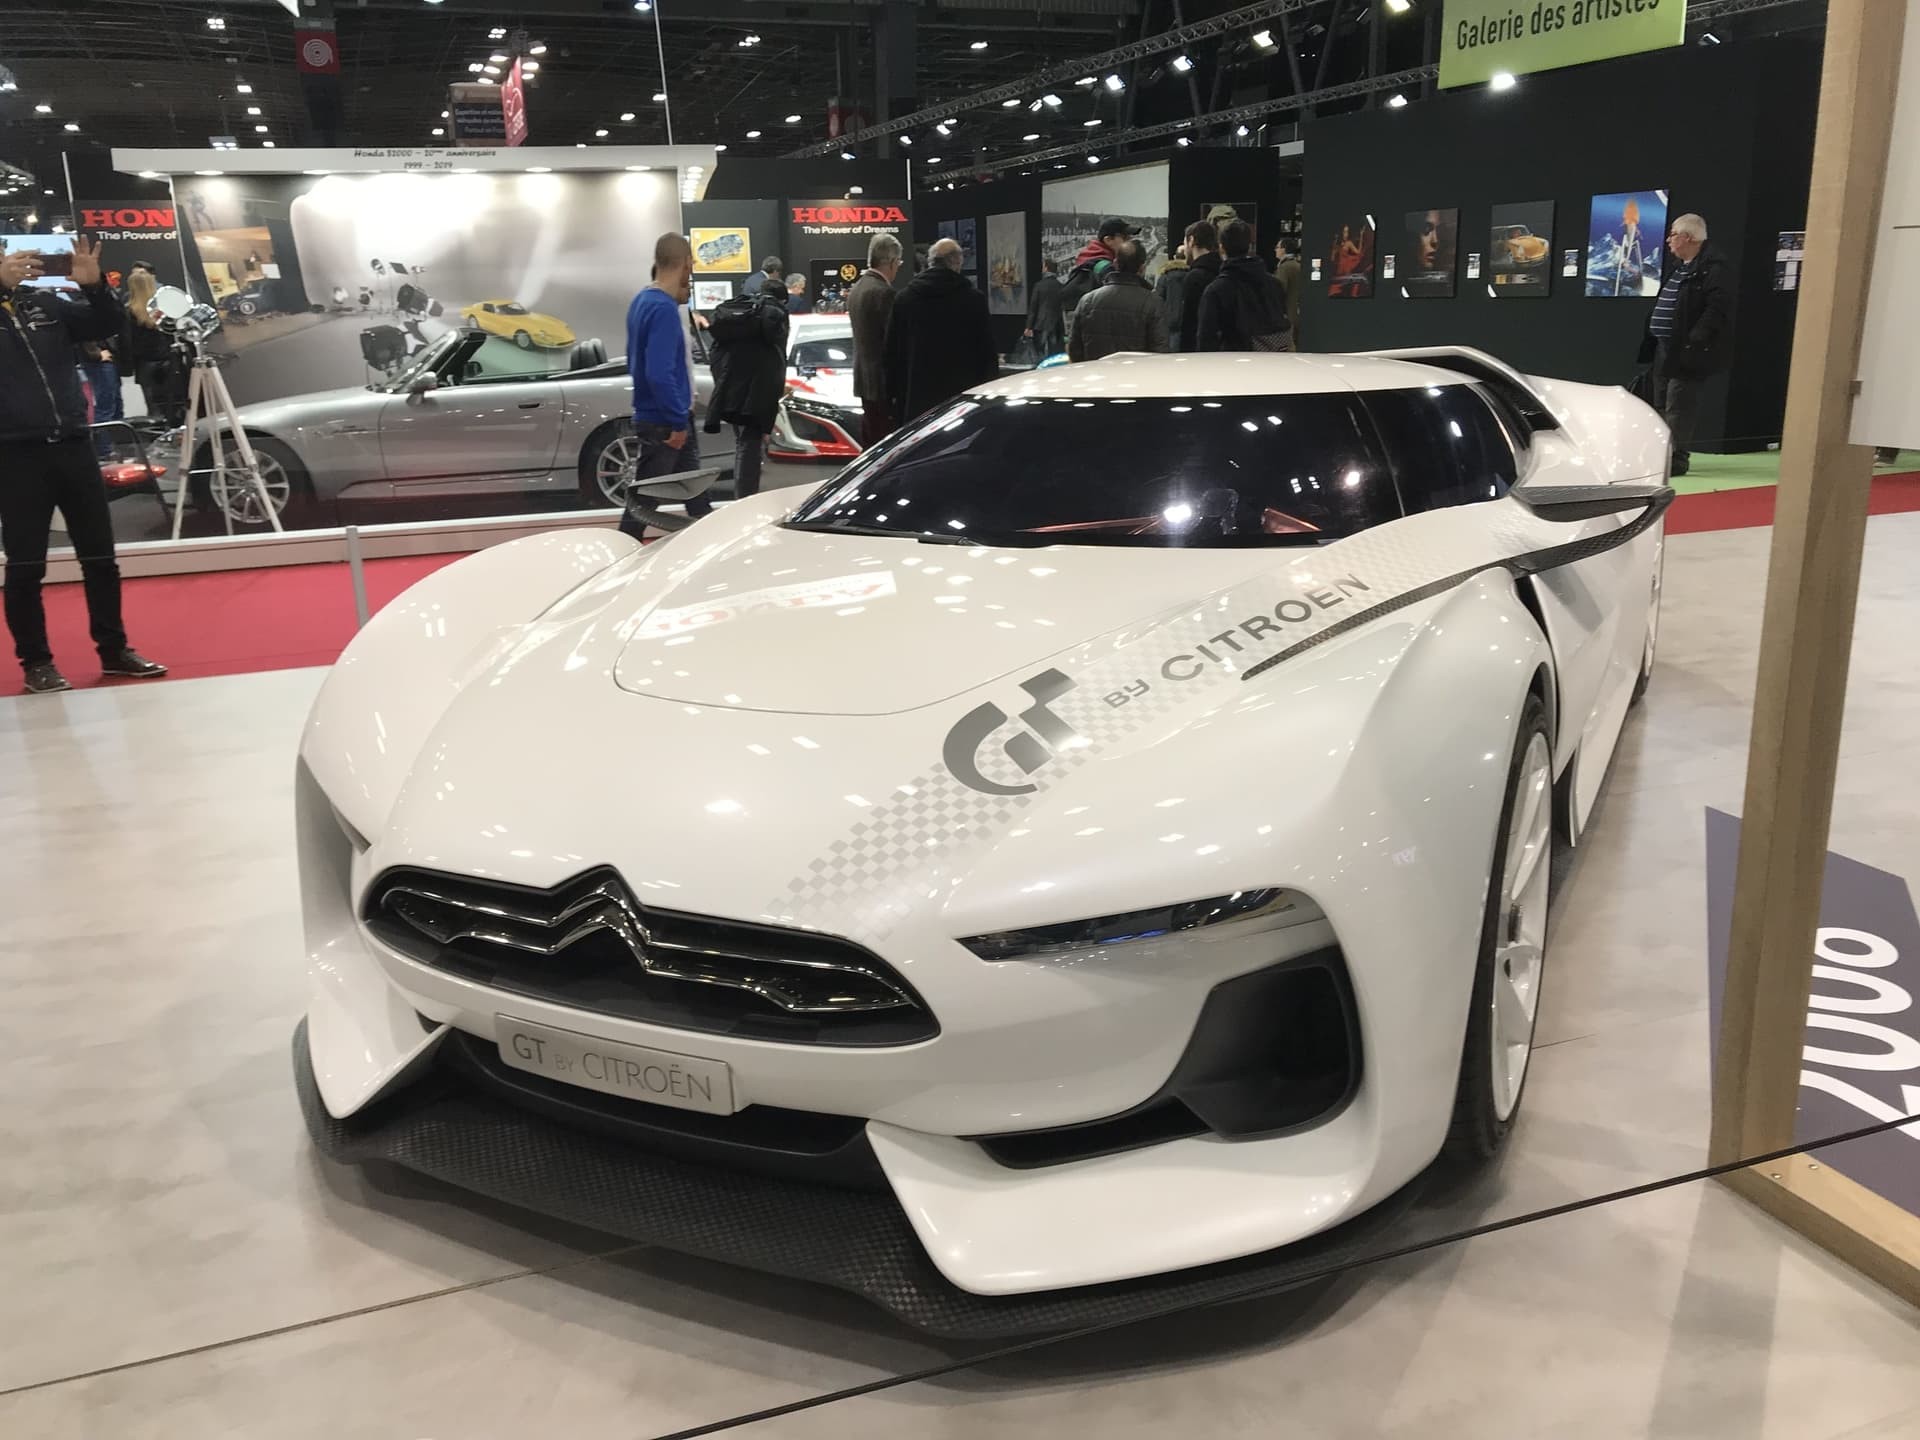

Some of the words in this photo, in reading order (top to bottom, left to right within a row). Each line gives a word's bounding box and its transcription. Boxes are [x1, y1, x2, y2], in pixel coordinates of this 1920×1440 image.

[1457, 9, 1523, 50] Galerie
[1531, 2, 1565, 35] des
[354, 149, 384, 157] Honda
[387, 149, 413, 157] S2000
[446, 148, 496, 157] anniversaire
[791, 207, 909, 223] HONDA
[96, 231, 121, 240] The
[122, 231, 161, 240] Power
[163, 230, 177, 239] of
[802, 226, 820, 234] The
[822, 226, 850, 234] Power
[852, 226, 862, 234] of
[864, 226, 899, 234] Dreams
[512, 1032, 546, 1065] GT
[553, 1054, 575, 1073] BY
[582, 1052, 713, 1102] CITROËN
